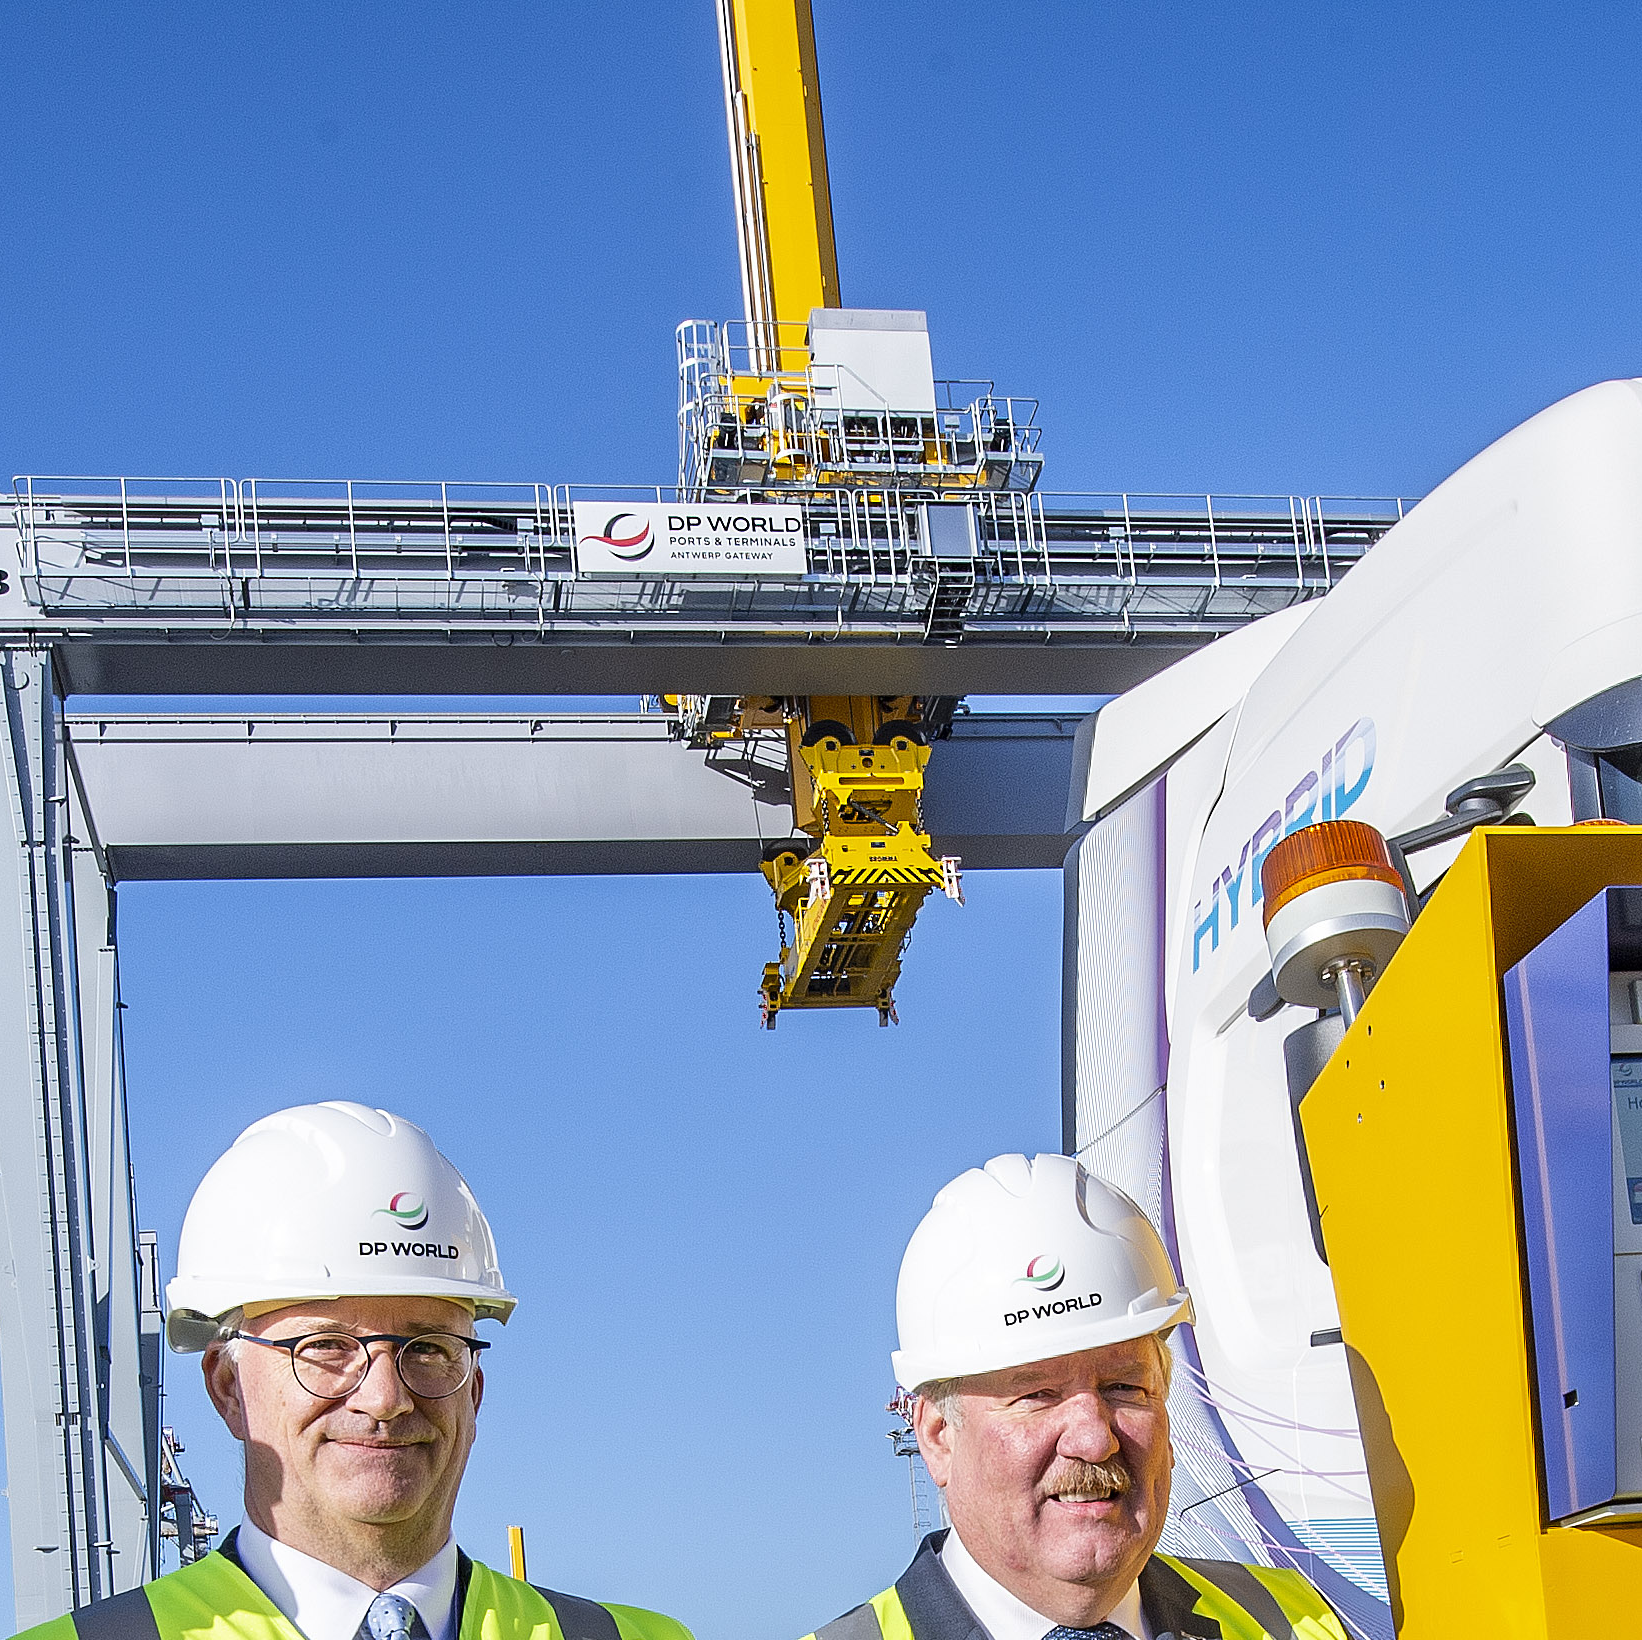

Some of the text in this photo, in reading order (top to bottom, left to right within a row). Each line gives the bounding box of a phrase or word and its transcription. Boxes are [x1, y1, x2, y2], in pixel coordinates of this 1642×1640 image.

[668, 515, 801, 533] DP WORLD
[669, 536, 797, 547] PORTS & TERMINALS
[670, 551, 774, 560] ANTWERP GATEWAY
[359, 1242, 460, 1260] DP WORLD
[1004, 1293, 1102, 1326] DP WORLD
